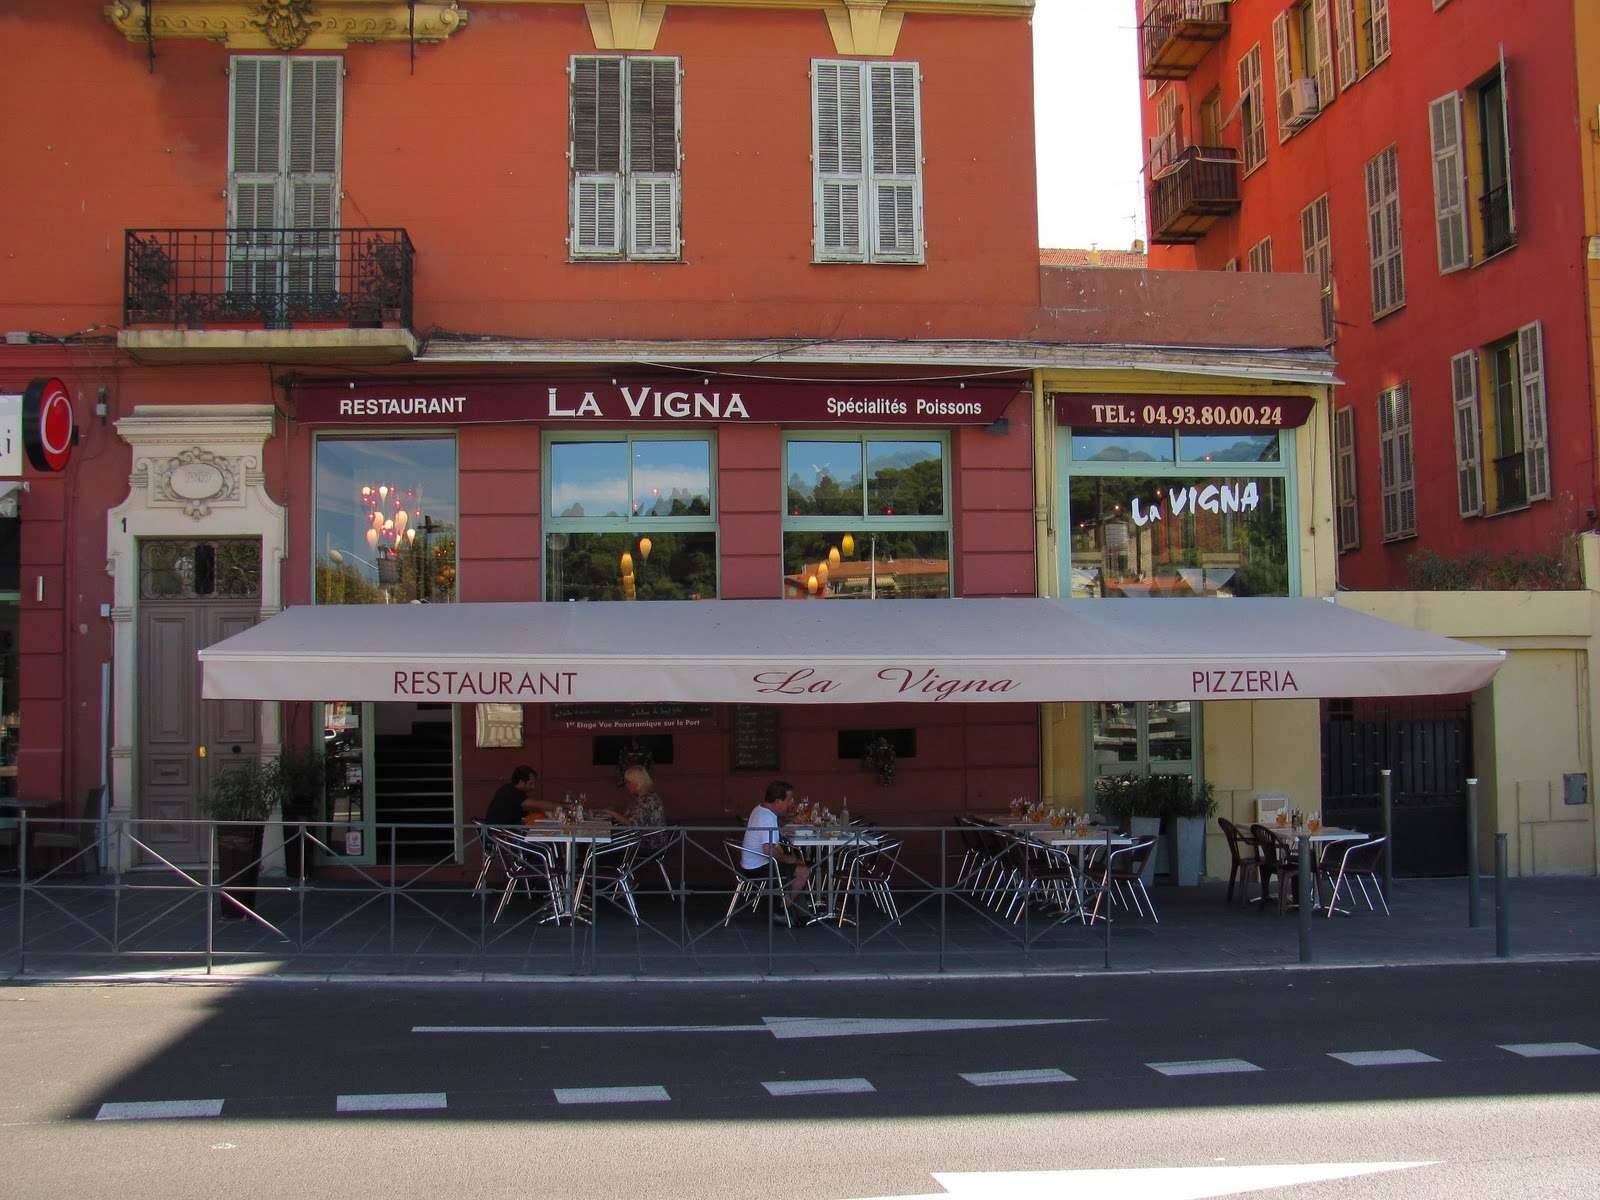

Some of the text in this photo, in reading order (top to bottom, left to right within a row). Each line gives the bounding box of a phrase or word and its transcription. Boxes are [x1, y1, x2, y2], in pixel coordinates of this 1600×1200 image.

[340, 398, 466, 415] RESTAURANT
[826, 397, 982, 416] Spécialités Poissons
[1092, 405, 1282, 425] TEL: 04.93.80.00.24
[1169, 482, 1259, 517] VIGNA
[121, 517, 127, 533] 1
[393, 671, 578, 695] RESTAURANT
[753, 667, 1021, 702] La Vigna
[1192, 670, 1299, 693] PIZZERIA
[599, 721, 612, 729] Vue
[676, 719, 684, 727] le
[685, 719, 700, 727] Port
